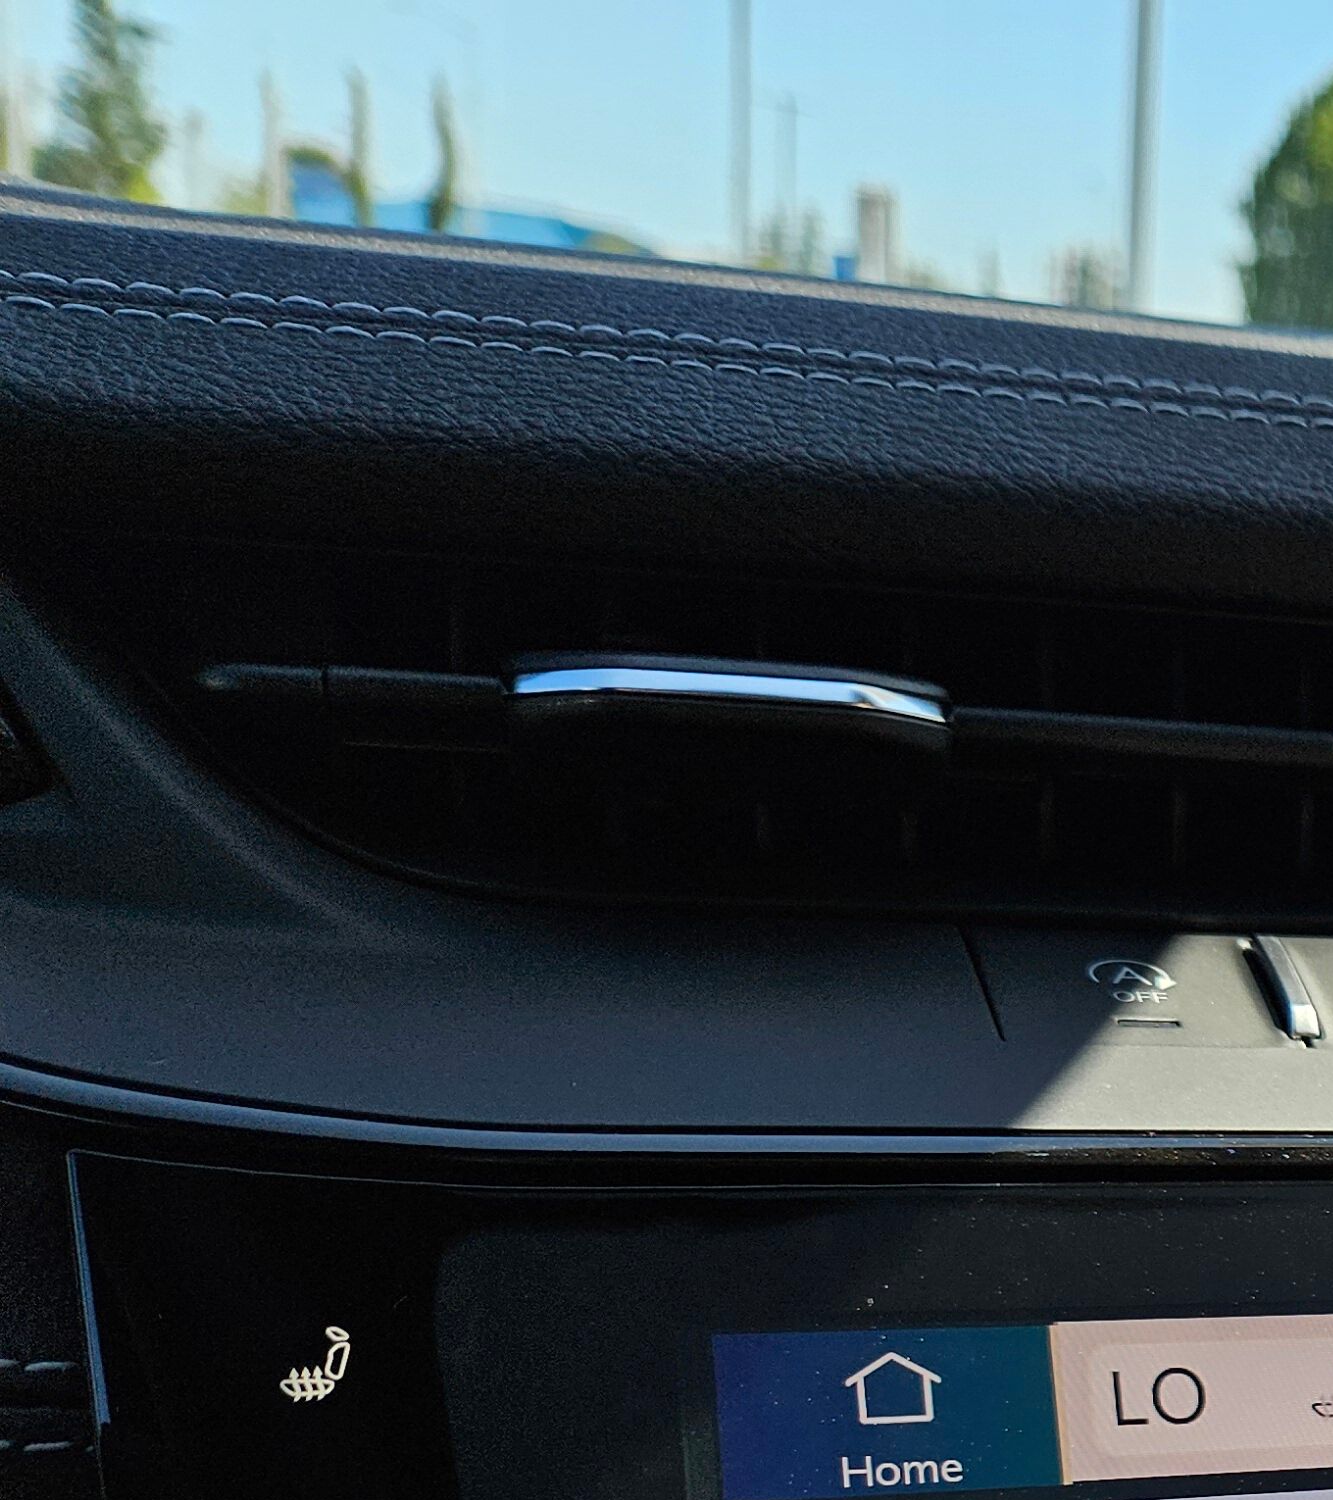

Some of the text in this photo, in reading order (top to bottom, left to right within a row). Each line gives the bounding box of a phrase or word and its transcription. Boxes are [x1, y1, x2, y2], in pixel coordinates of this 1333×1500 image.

[1113, 991, 1168, 1004] OFF
[1112, 1367, 1206, 1426] LO
[841, 1455, 963, 1488] Home
